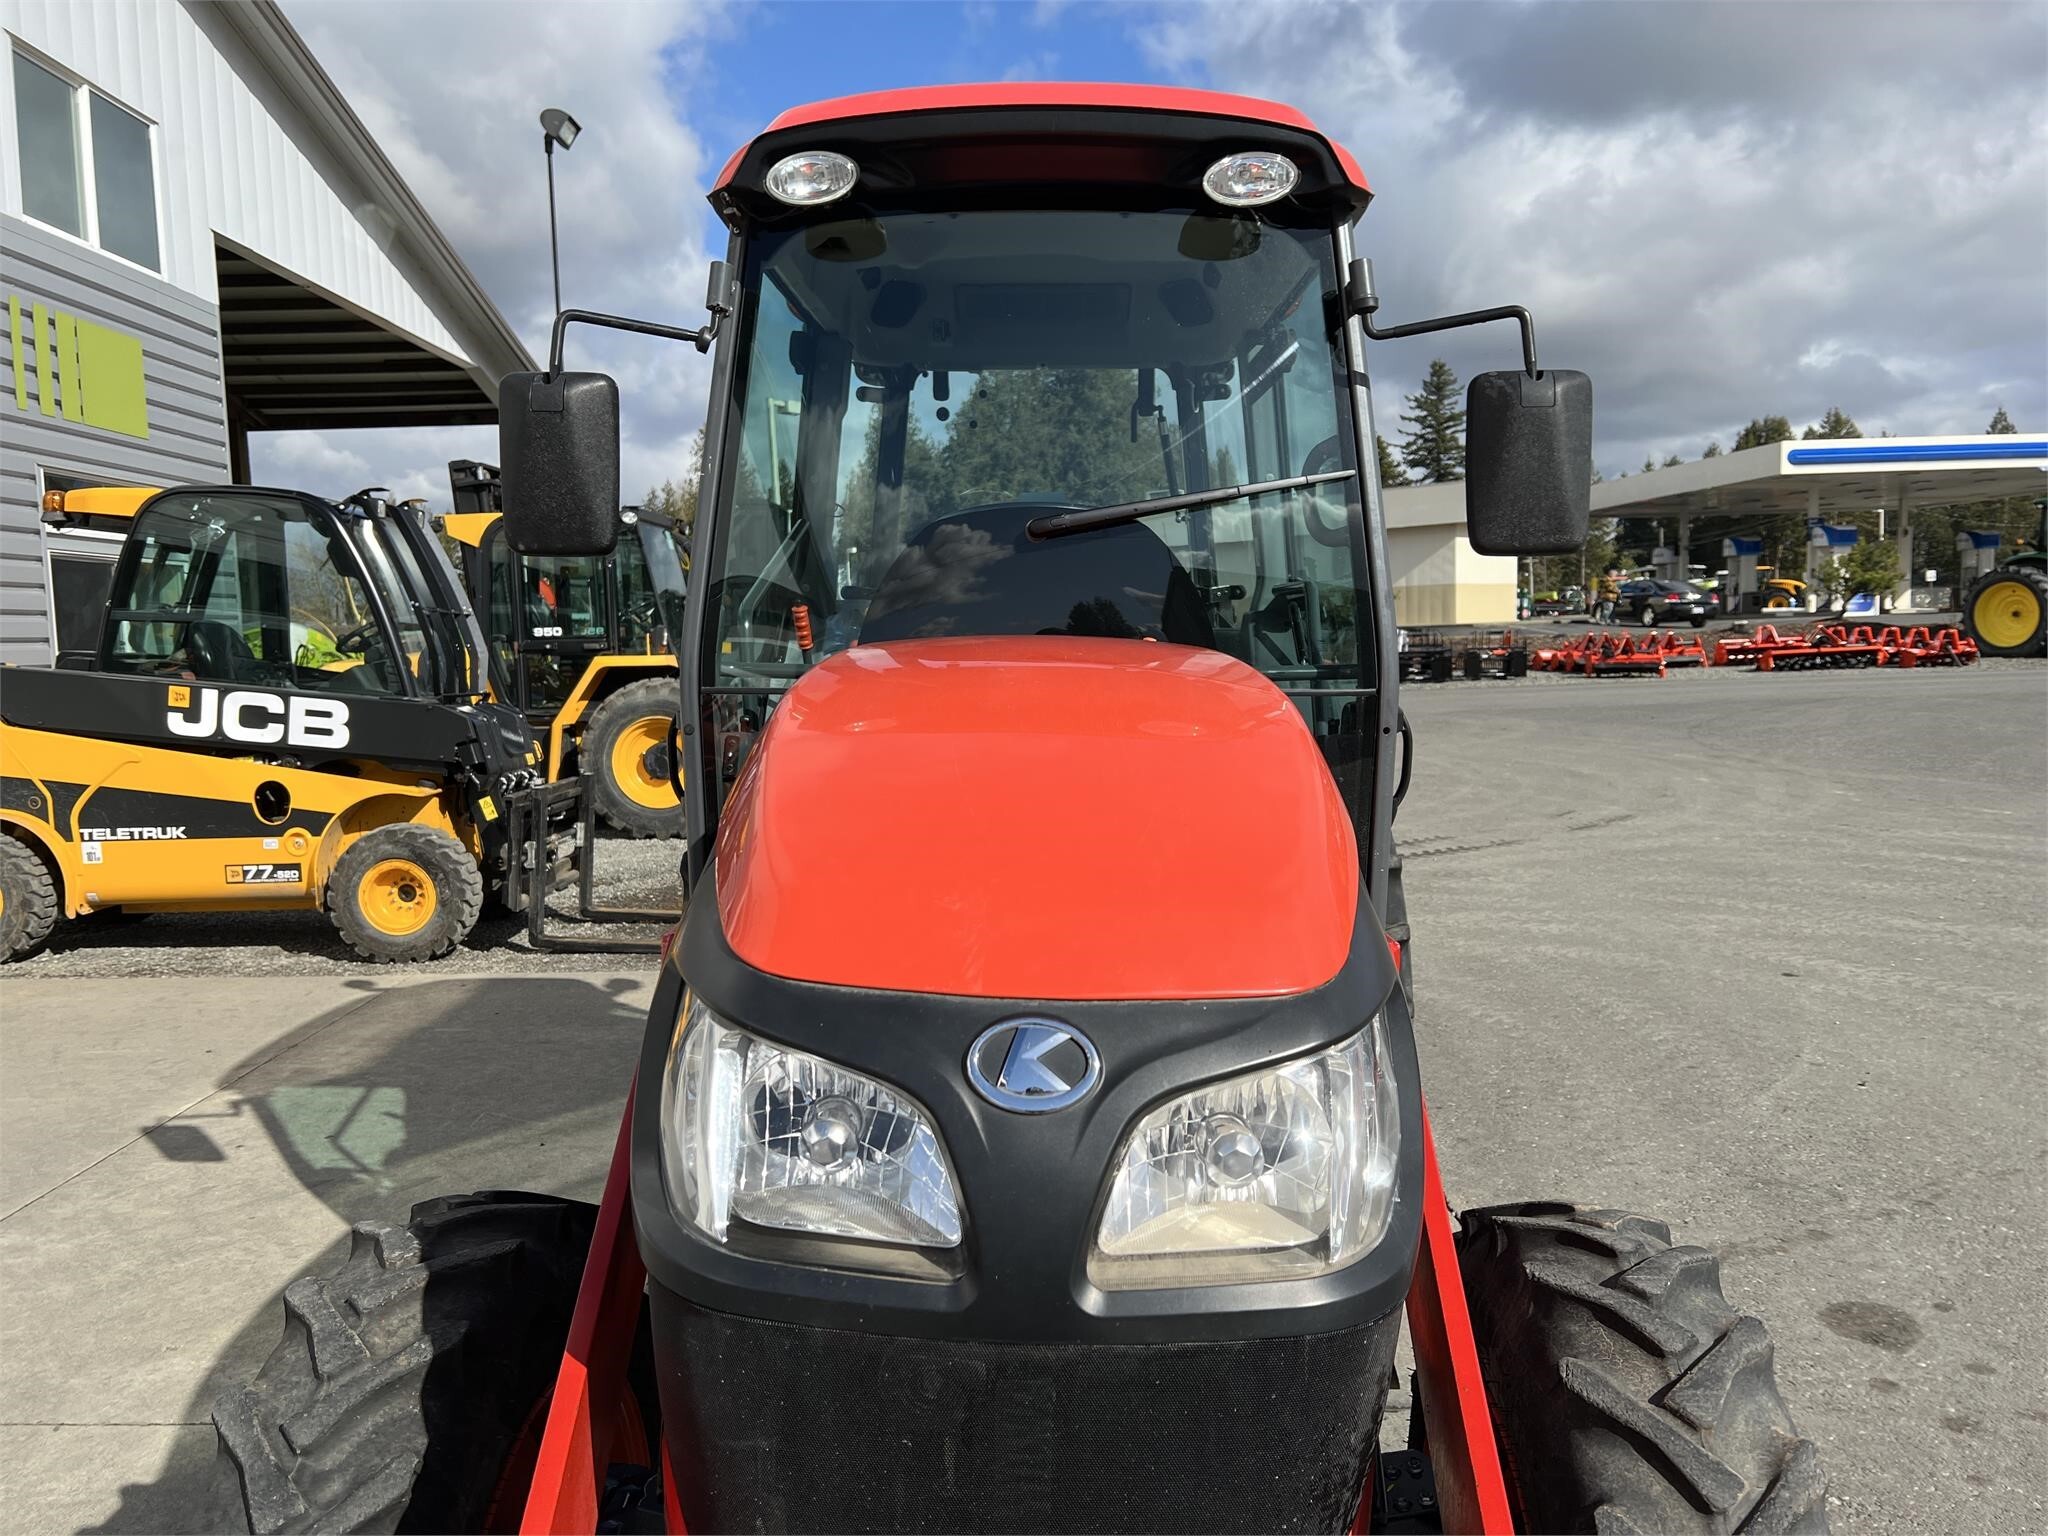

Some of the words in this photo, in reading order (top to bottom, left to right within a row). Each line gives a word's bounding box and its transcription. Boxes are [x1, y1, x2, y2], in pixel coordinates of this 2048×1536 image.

[533, 627, 562, 637] 950
[167, 688, 350, 749] JCB
[79, 826, 187, 841] TELETRUK
